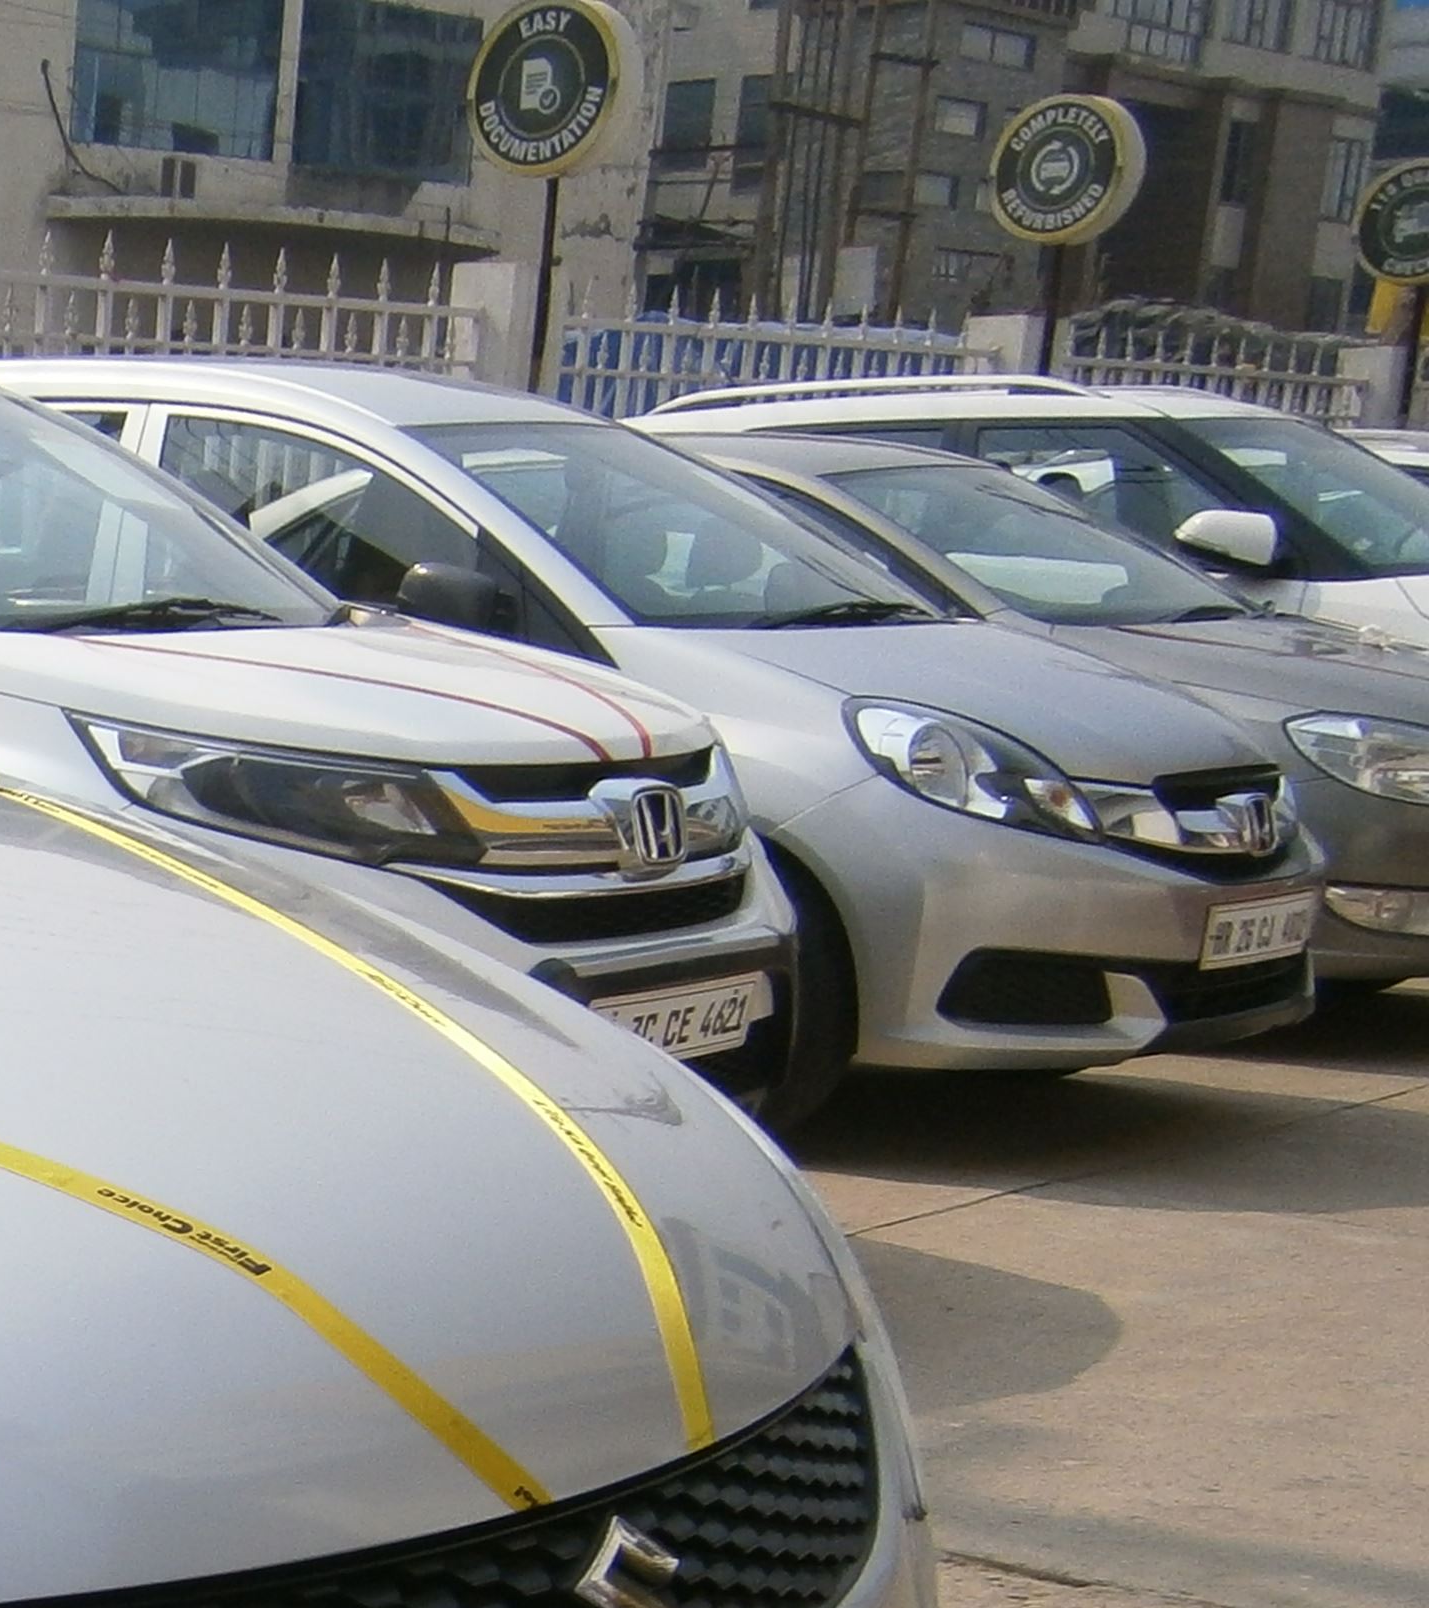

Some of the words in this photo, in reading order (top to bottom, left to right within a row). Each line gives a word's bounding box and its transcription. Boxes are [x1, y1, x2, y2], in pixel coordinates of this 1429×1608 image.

[518, 11, 571, 38] EASY
[479, 86, 603, 161] DOCUMENTATION
[1010, 107, 1110, 151] COMPLETELY
[1001, 184, 1104, 230] REFURBISHED
[663, 1005, 696, 1047] CE
[699, 994, 749, 1039] 4621
[97, 1188, 194, 1235] Choice
[196, 1230, 272, 1276] First
